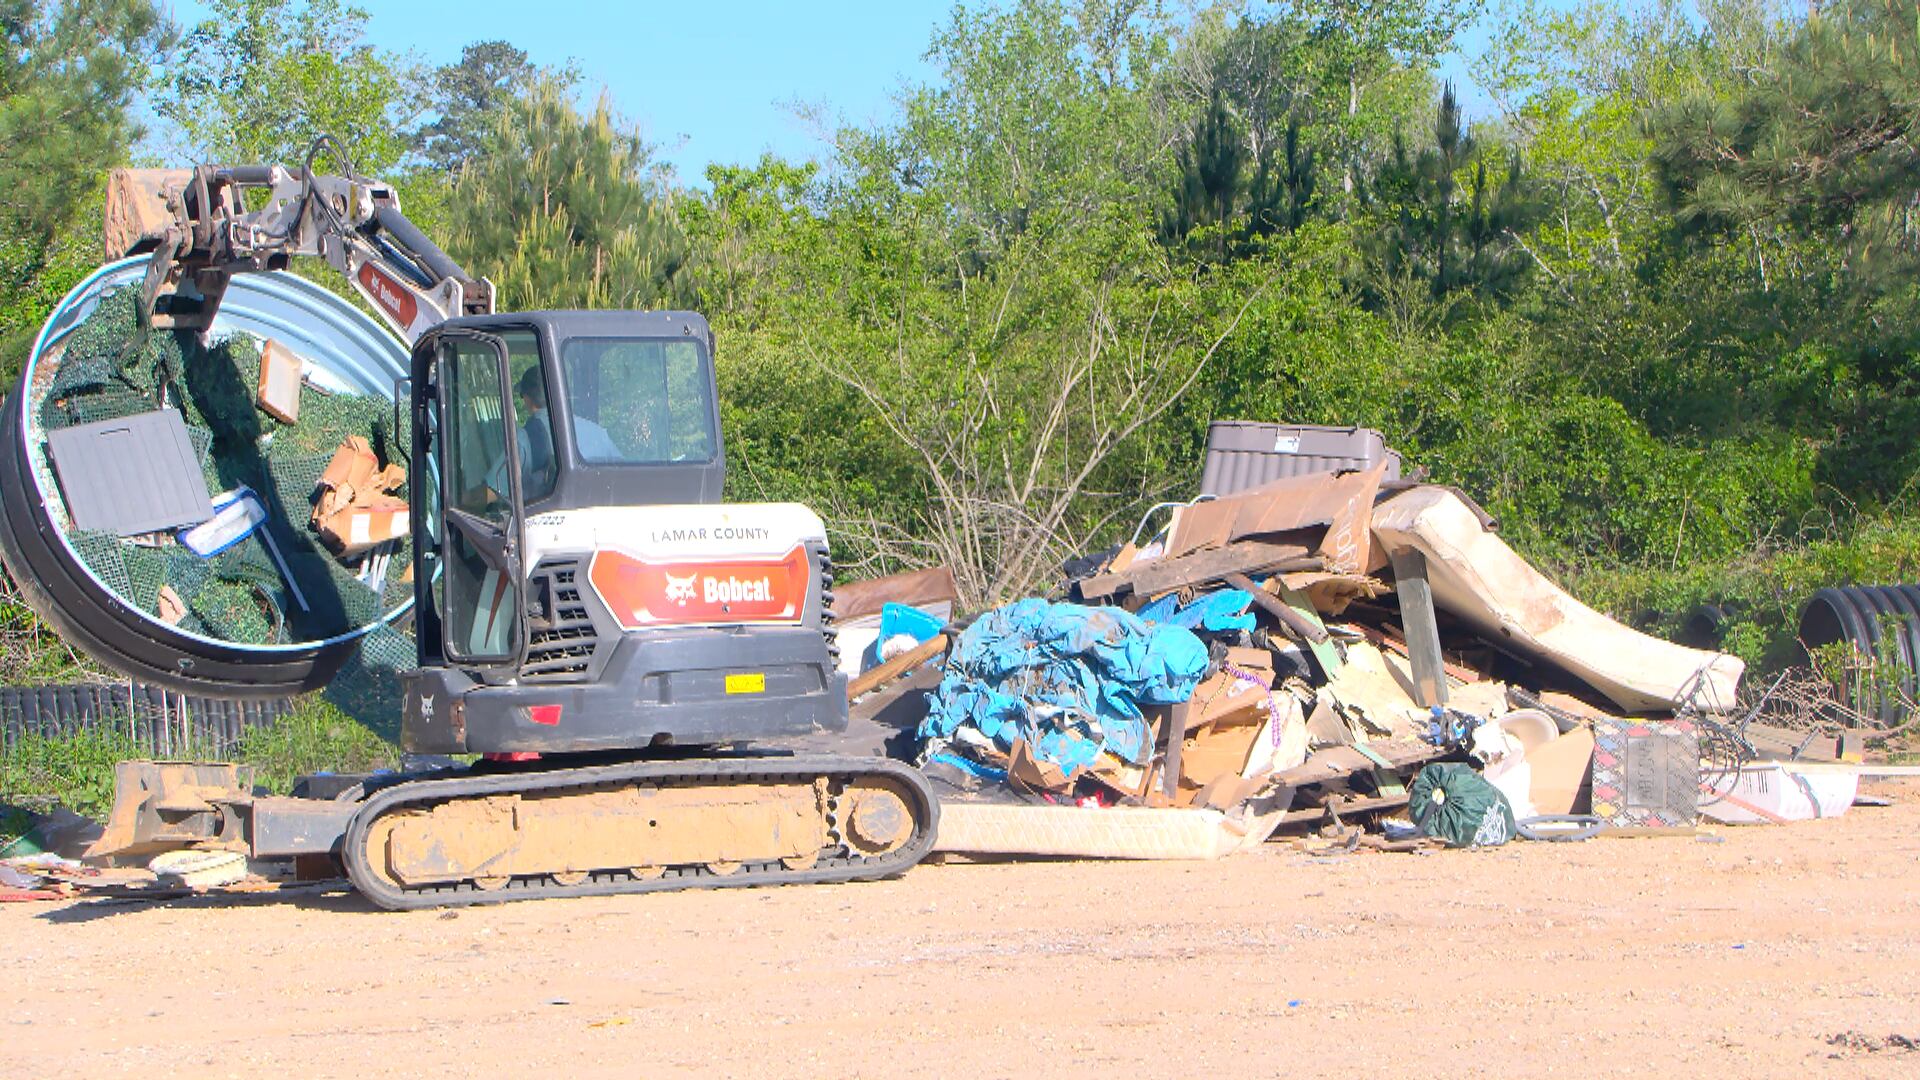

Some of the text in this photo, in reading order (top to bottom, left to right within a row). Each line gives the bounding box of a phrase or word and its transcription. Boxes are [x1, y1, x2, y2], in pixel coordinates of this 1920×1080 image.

[380, 283, 401, 313] Bobcat
[652, 527, 769, 543] LAMAR COUNTY
[703, 575, 771, 603] Bobcat
